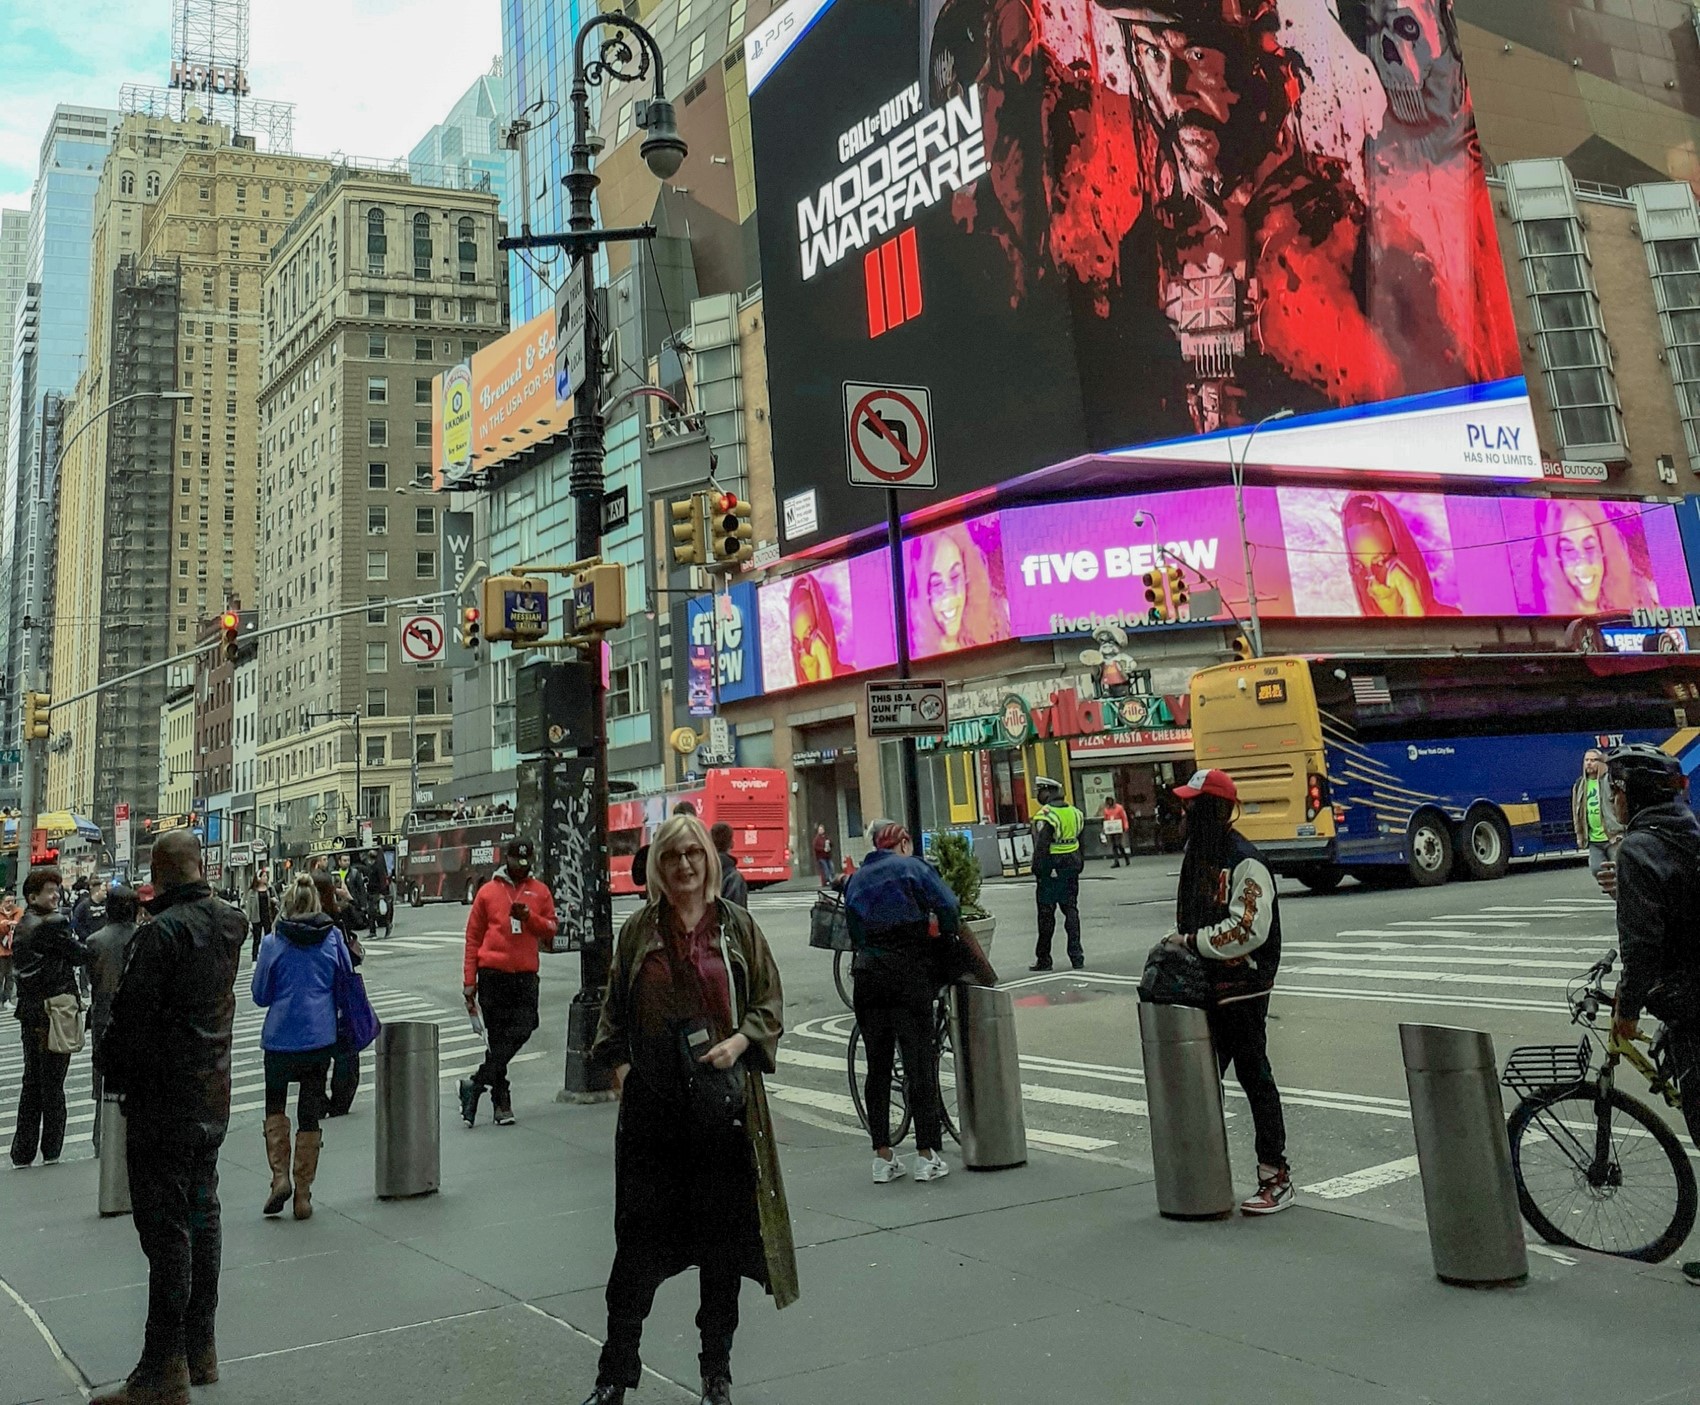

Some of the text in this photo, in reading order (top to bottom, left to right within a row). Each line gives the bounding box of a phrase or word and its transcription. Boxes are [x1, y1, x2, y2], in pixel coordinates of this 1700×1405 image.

[765, 11, 795, 47] PS5
[170, 60, 250, 95] HOTEL
[837, 116, 875, 164] CALL
[797, 82, 984, 242] MODERN
[570, 303, 584, 331] ROUTE
[479, 357, 524, 412] Brewed
[479, 424, 489, 440] IN
[488, 411, 506, 428] THE
[506, 393, 523, 418] USA
[523, 376, 542, 400] FOR
[1465, 423, 1521, 450] PLAY
[1463, 451, 1484, 463] HAS
[1485, 452, 1500, 464] NO
[1543, 461, 1605, 477] BIG OUTDOOR
[786, 507, 796, 526] M
[1020, 550, 1100, 587] five
[446, 534, 471, 644] WESIN
[1632, 607, 1669, 628] five
[871, 693, 913, 703] THIS IS A
[871, 703, 917, 713] GUN FE
[872, 714, 898, 723] ZONE
[1004, 708, 1026, 728] villa
[1078, 734, 1105, 747] PIZZA
[1114, 731, 1142, 744] PASTA
[1595, 734, 1624, 748] I NY
